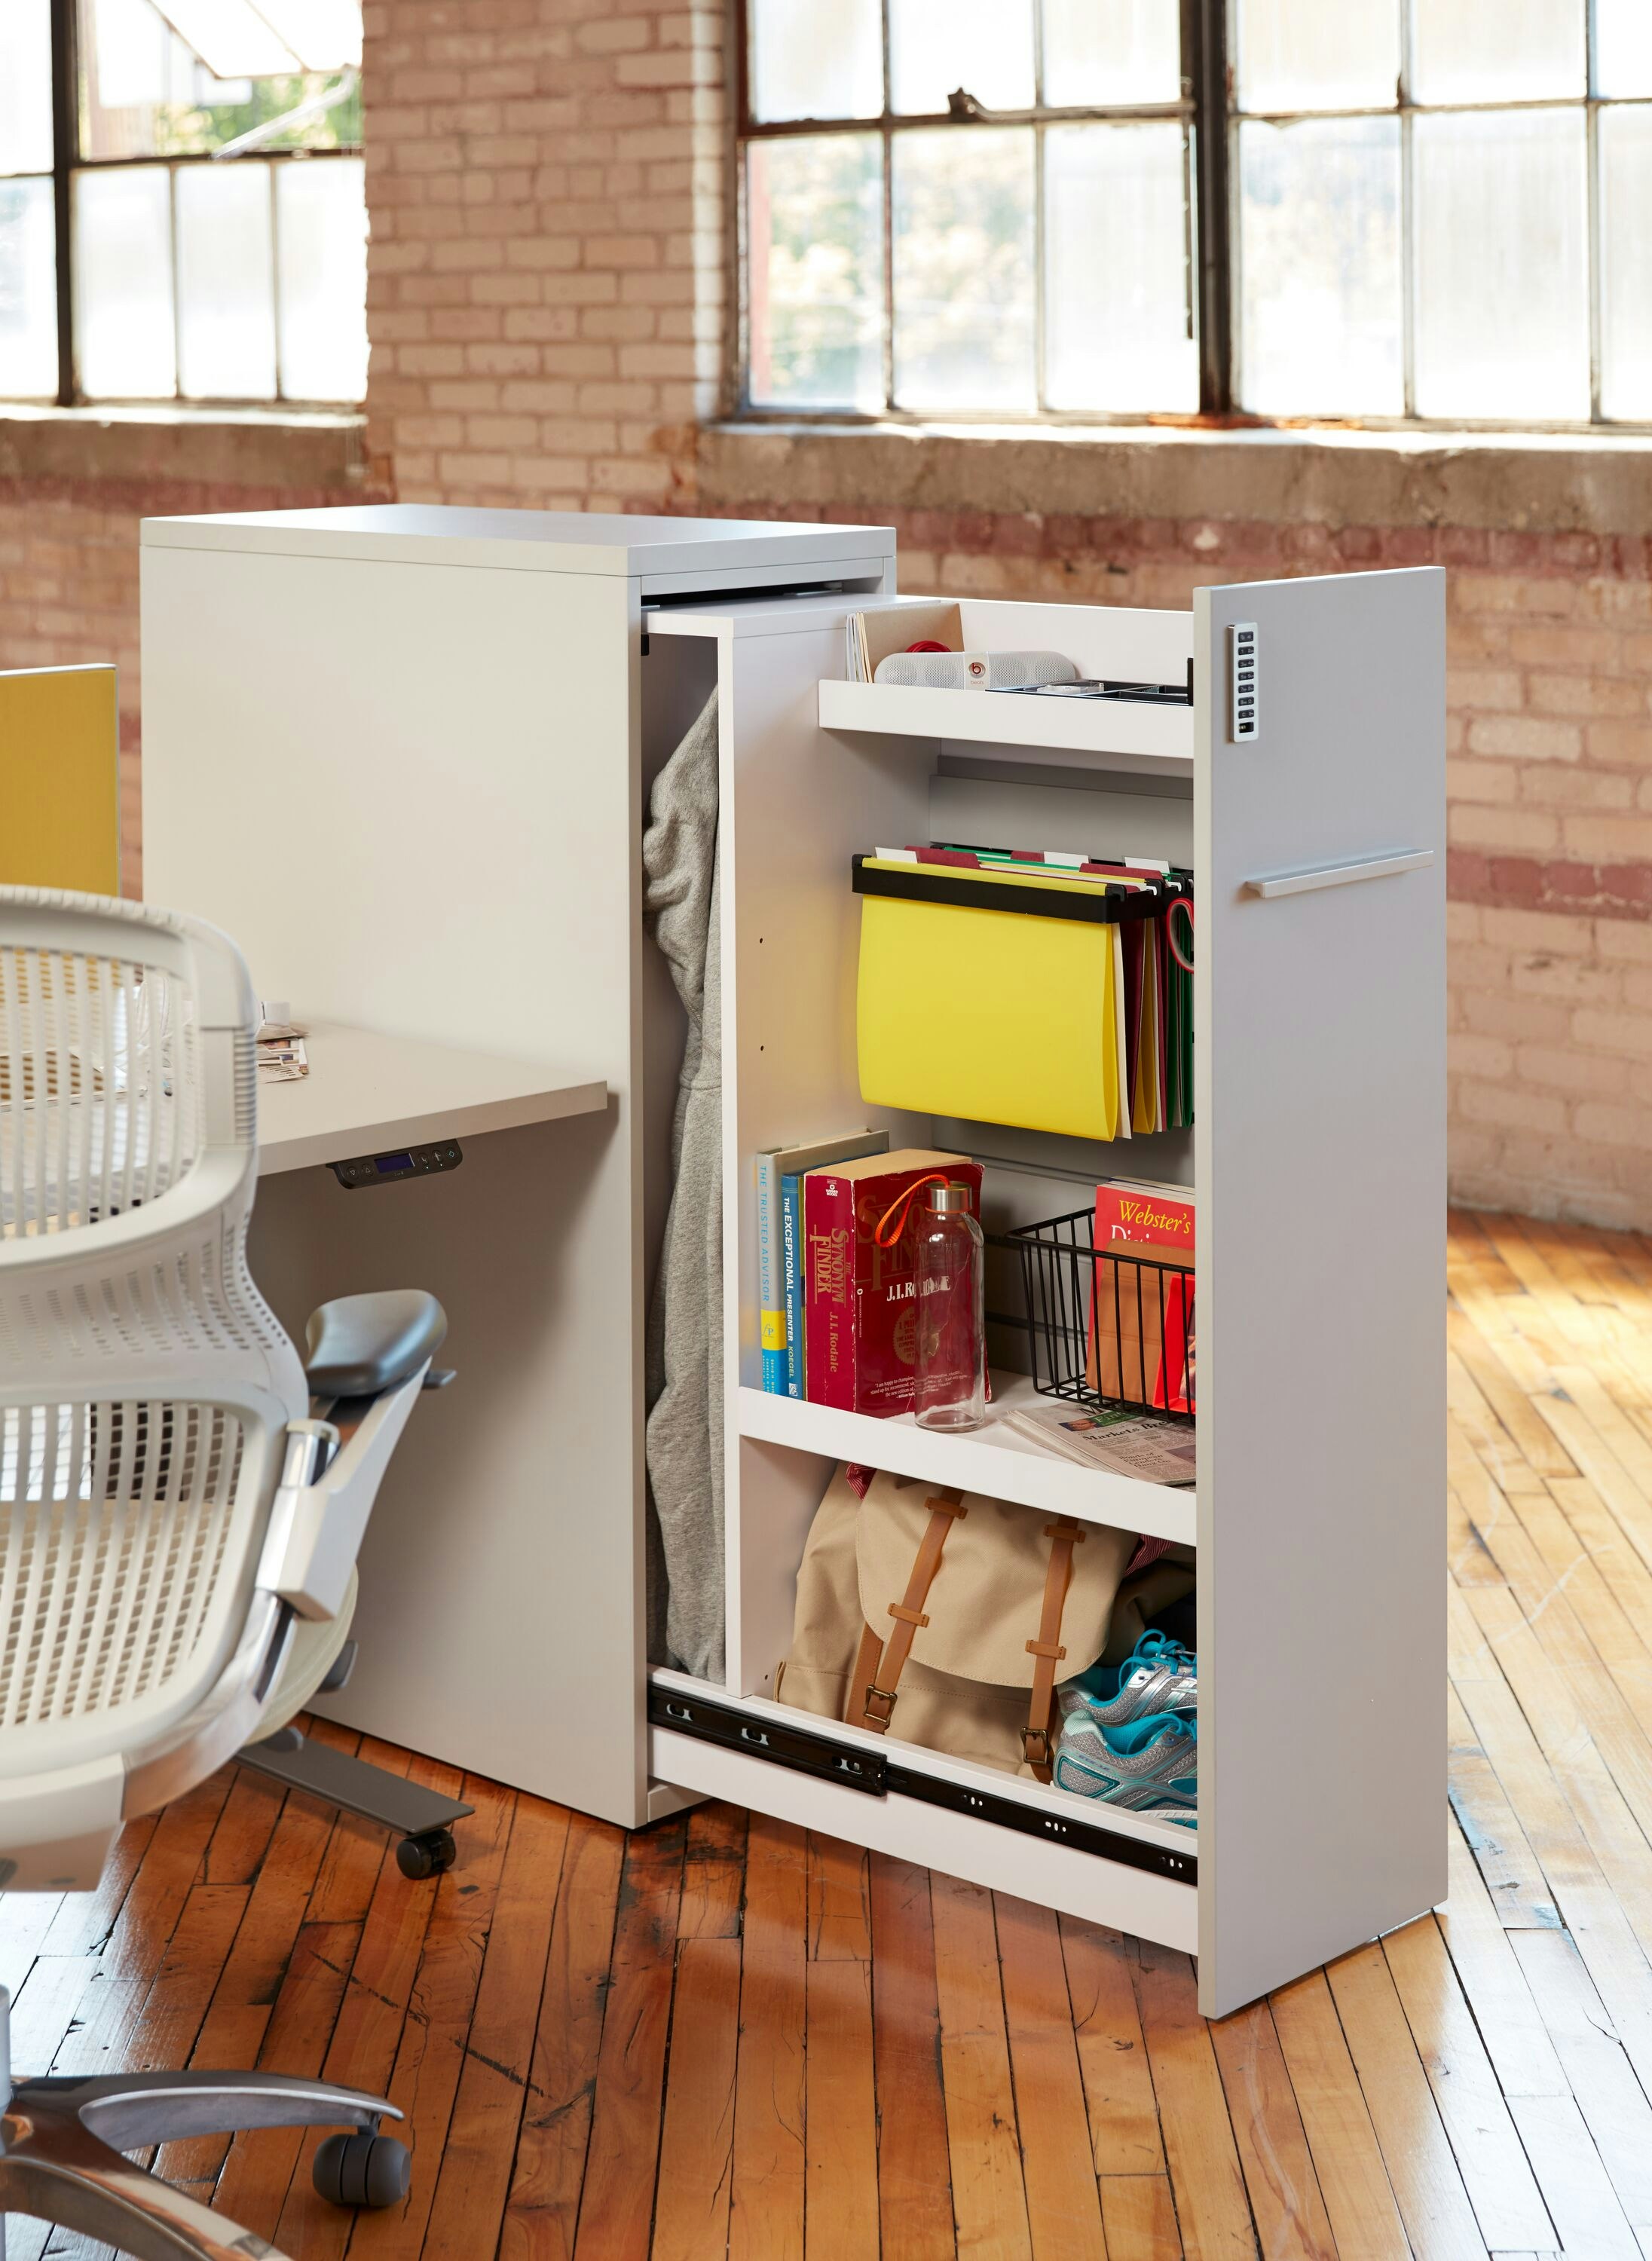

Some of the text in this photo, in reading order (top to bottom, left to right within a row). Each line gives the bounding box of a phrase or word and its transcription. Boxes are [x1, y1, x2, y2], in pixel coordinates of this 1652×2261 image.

[760, 1193, 769, 1244] TRUSTED
[1119, 1199, 1192, 1234] Webster's
[761, 1248, 770, 1302] ADVISOR
[785, 1215, 794, 1292] EXCEPTIONAL
[809, 1234, 832, 1294] FINDER
[831, 1228, 849, 1304] SYNONYM
[830, 1332, 839, 1372] Rodale
[1081, 1427, 1140, 1441] Markets
